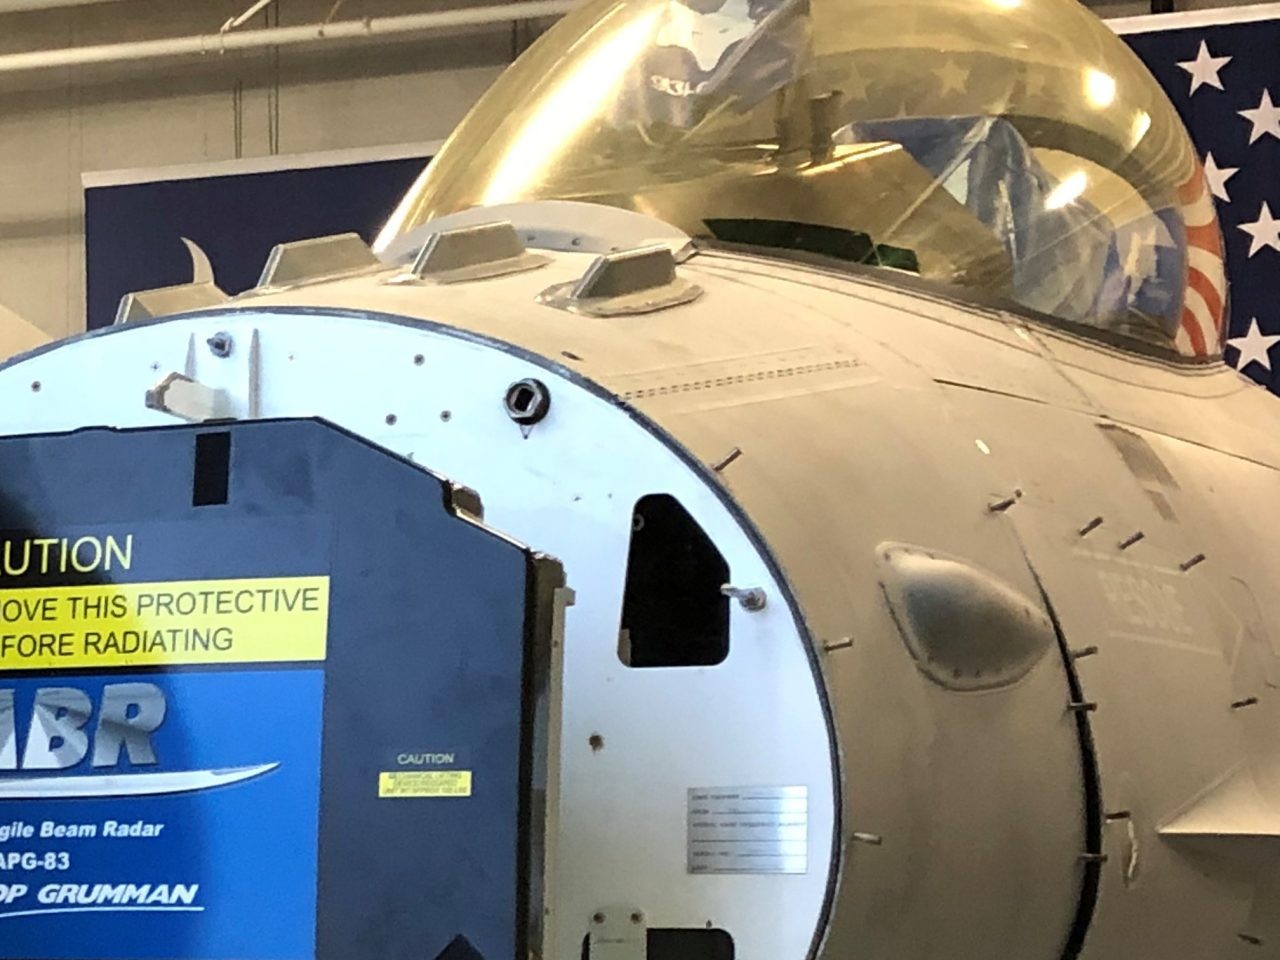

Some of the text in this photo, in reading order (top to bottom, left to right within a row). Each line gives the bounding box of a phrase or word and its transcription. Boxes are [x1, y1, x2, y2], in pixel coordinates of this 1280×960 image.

[69, 594, 128, 619] THIS
[136, 587, 320, 617] PROTECTIVE
[83, 627, 234, 656] RADIATING
[396, 752, 455, 765] CAUTION
[39, 821, 97, 839] Beam
[102, 820, 165, 838] Radar
[37, 883, 199, 905] GRUMMAN
